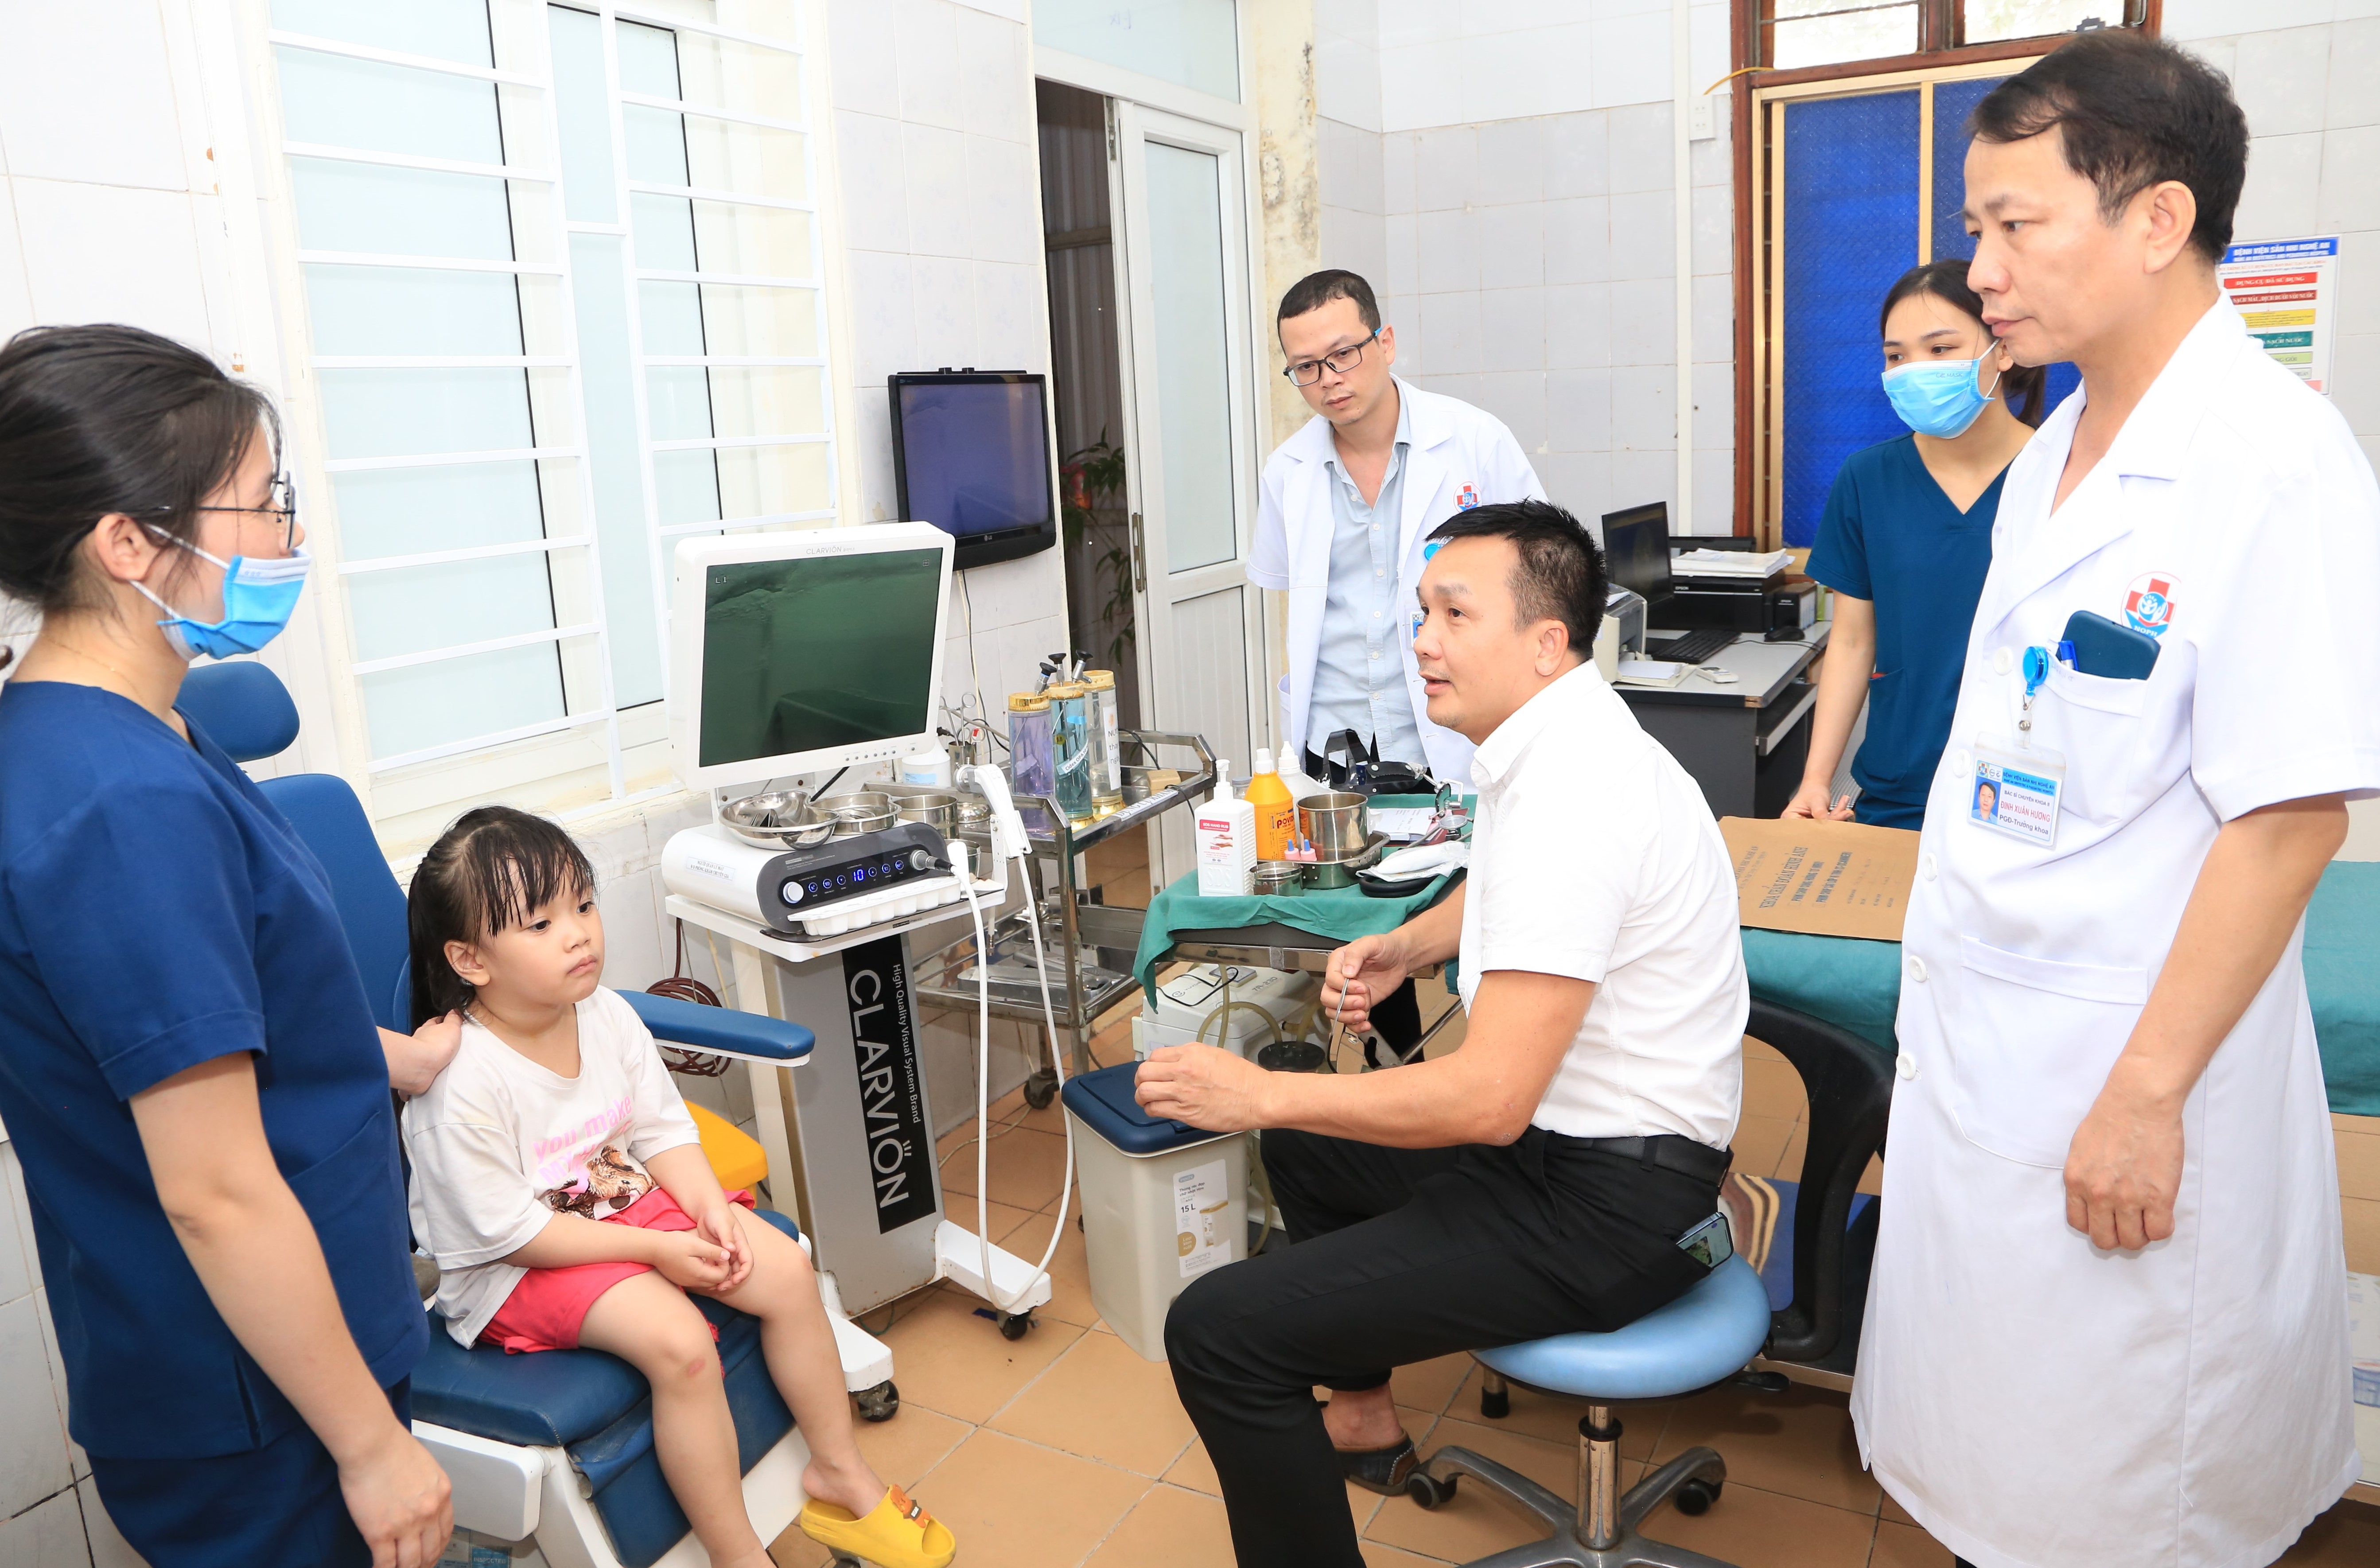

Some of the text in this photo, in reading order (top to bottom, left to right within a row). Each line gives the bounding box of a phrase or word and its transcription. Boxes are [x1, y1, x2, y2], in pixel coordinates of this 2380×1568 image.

[2134, 625, 2158, 637] NOPH
[1065, 753, 1084, 771] Cidex OPA
[2001, 801, 2051, 822] ĐINH XUÂN HƯƠNG
[1999, 814, 2049, 835] PGĐ-Trưởng khoa
[853, 869, 864, 882] 10
[1759, 895, 1780, 908] KHOA
[893, 964, 921, 1124] High Quality Visual System Brand
[584, 1096, 632, 1138] make
[1181, 1205, 1190, 1213] 15
